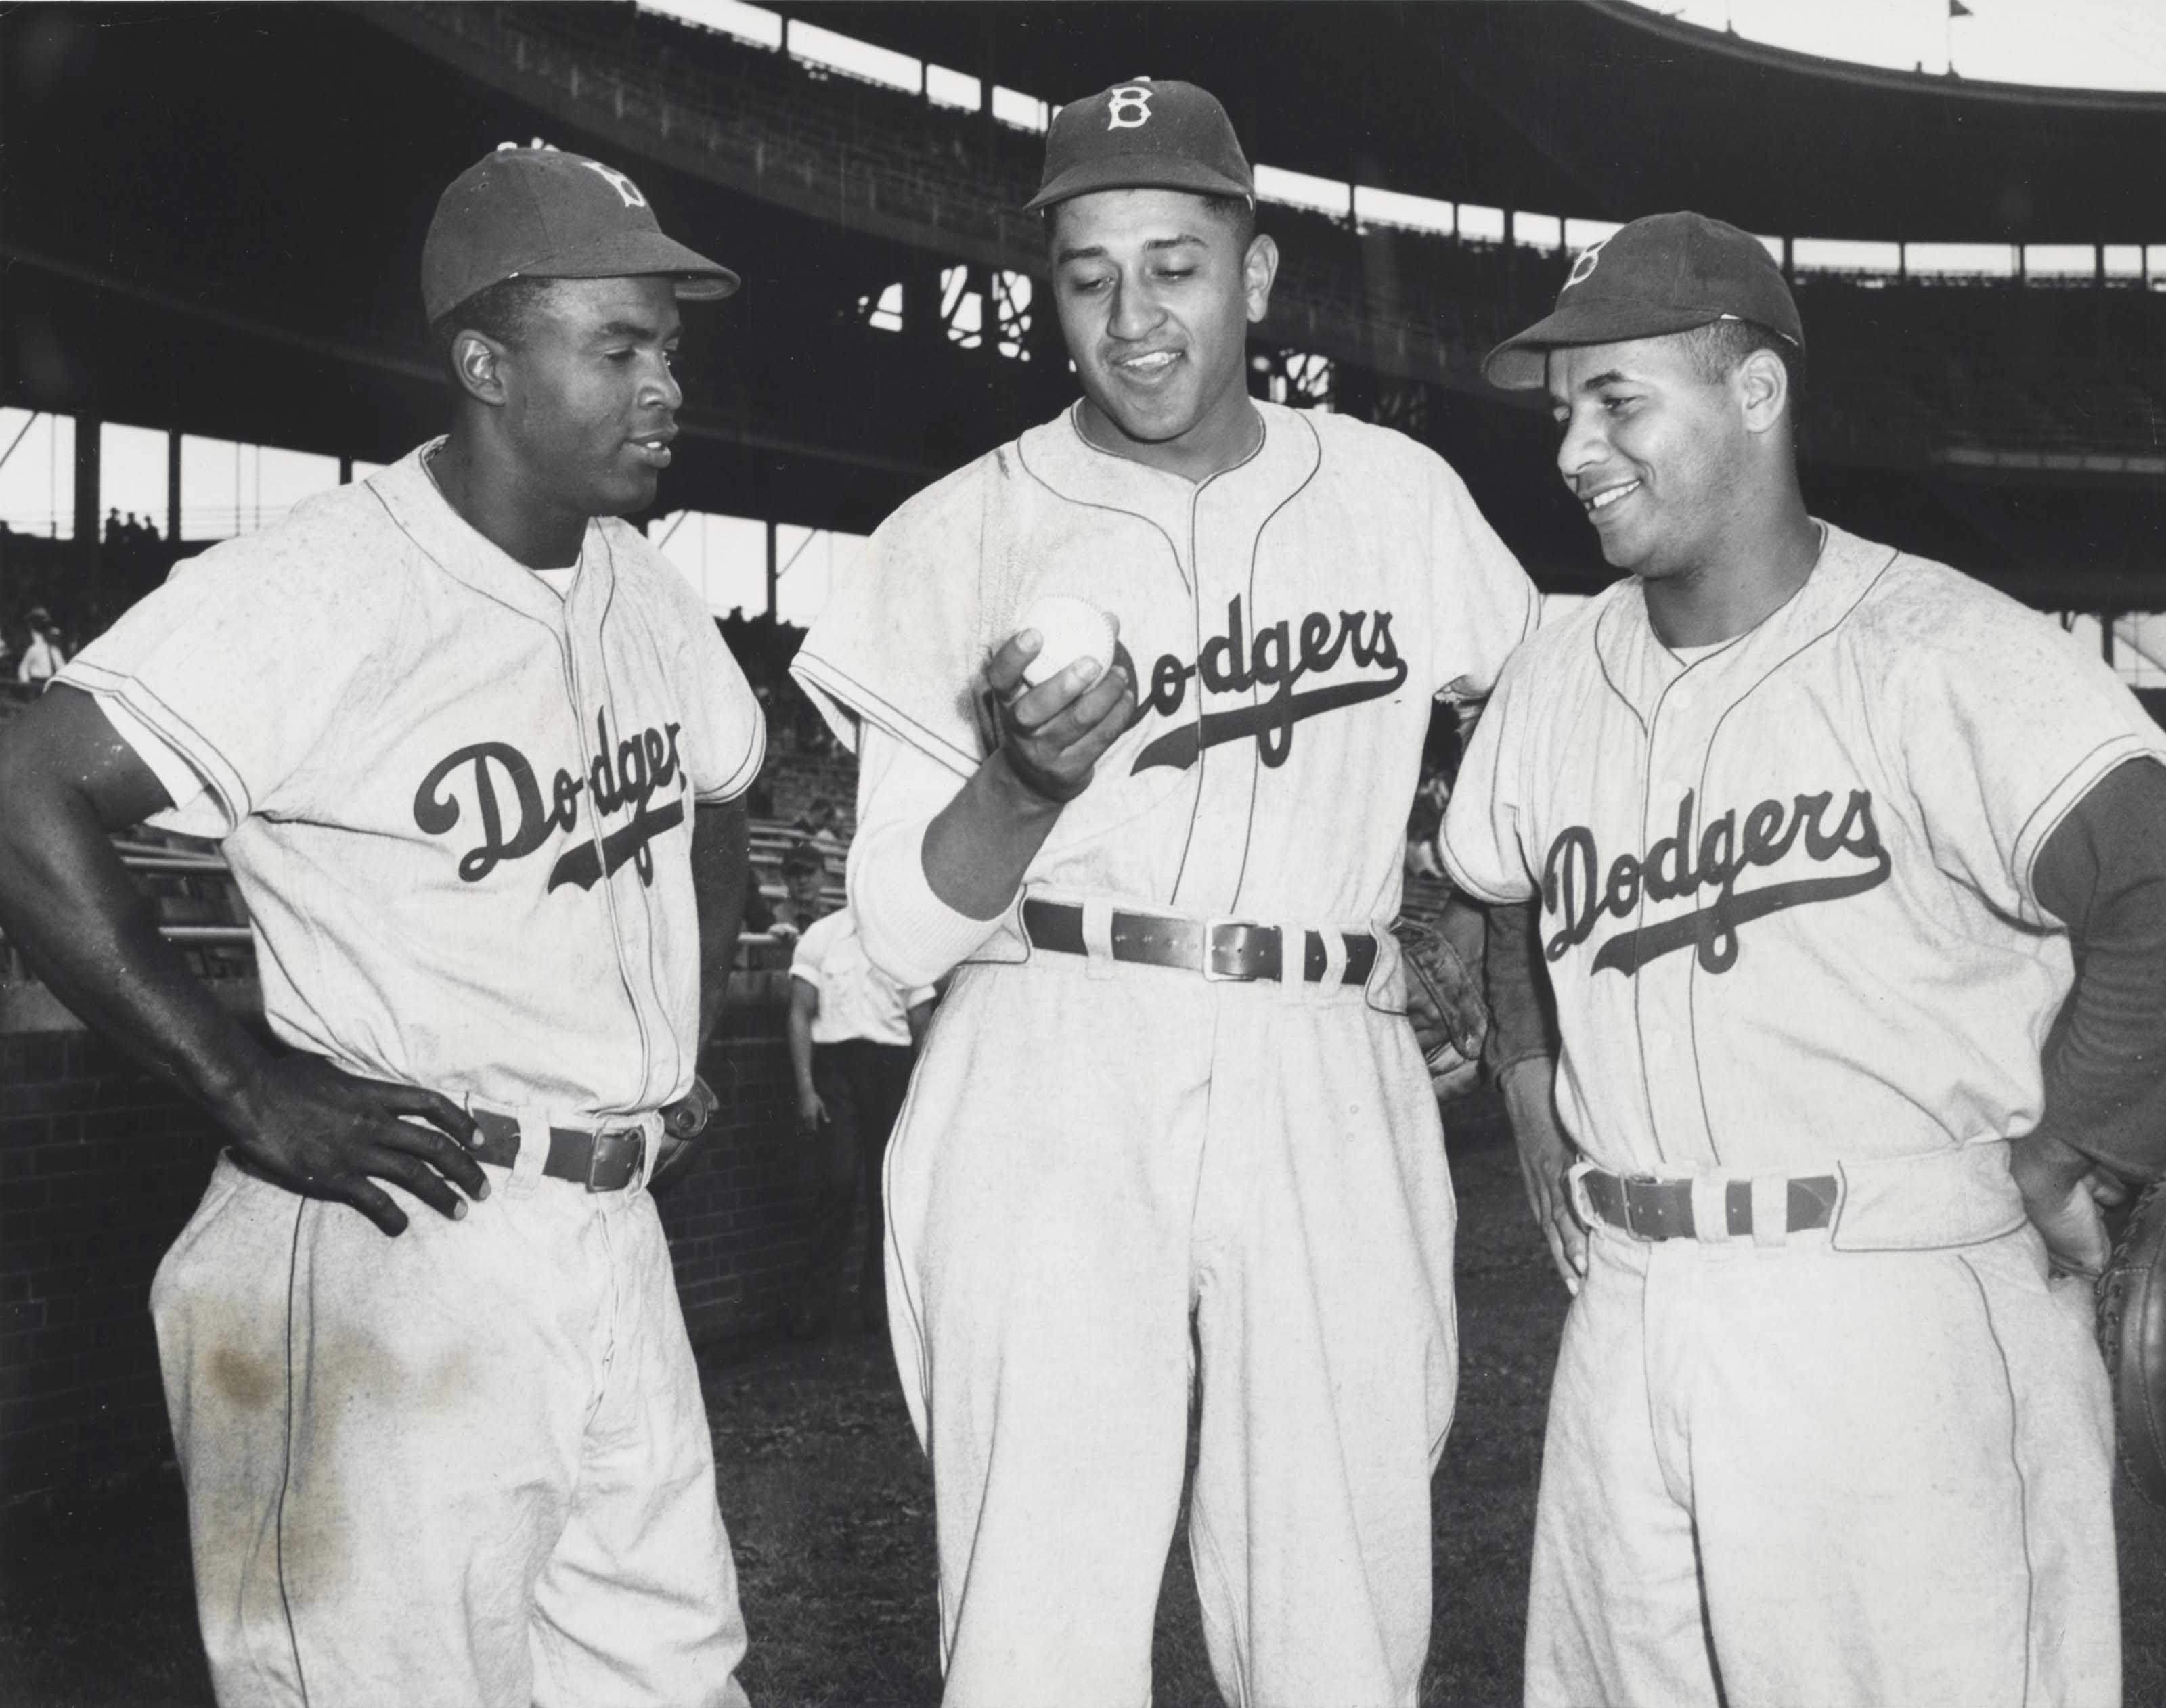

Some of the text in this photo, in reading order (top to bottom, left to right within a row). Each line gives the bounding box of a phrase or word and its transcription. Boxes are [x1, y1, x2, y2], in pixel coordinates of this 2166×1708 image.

[581, 162, 645, 208] B
[1107, 86, 1153, 131] B
[1114, 593, 1408, 776] odgers
[413, 704, 687, 895] Dodger
[1543, 787, 1891, 978] Dodgers
